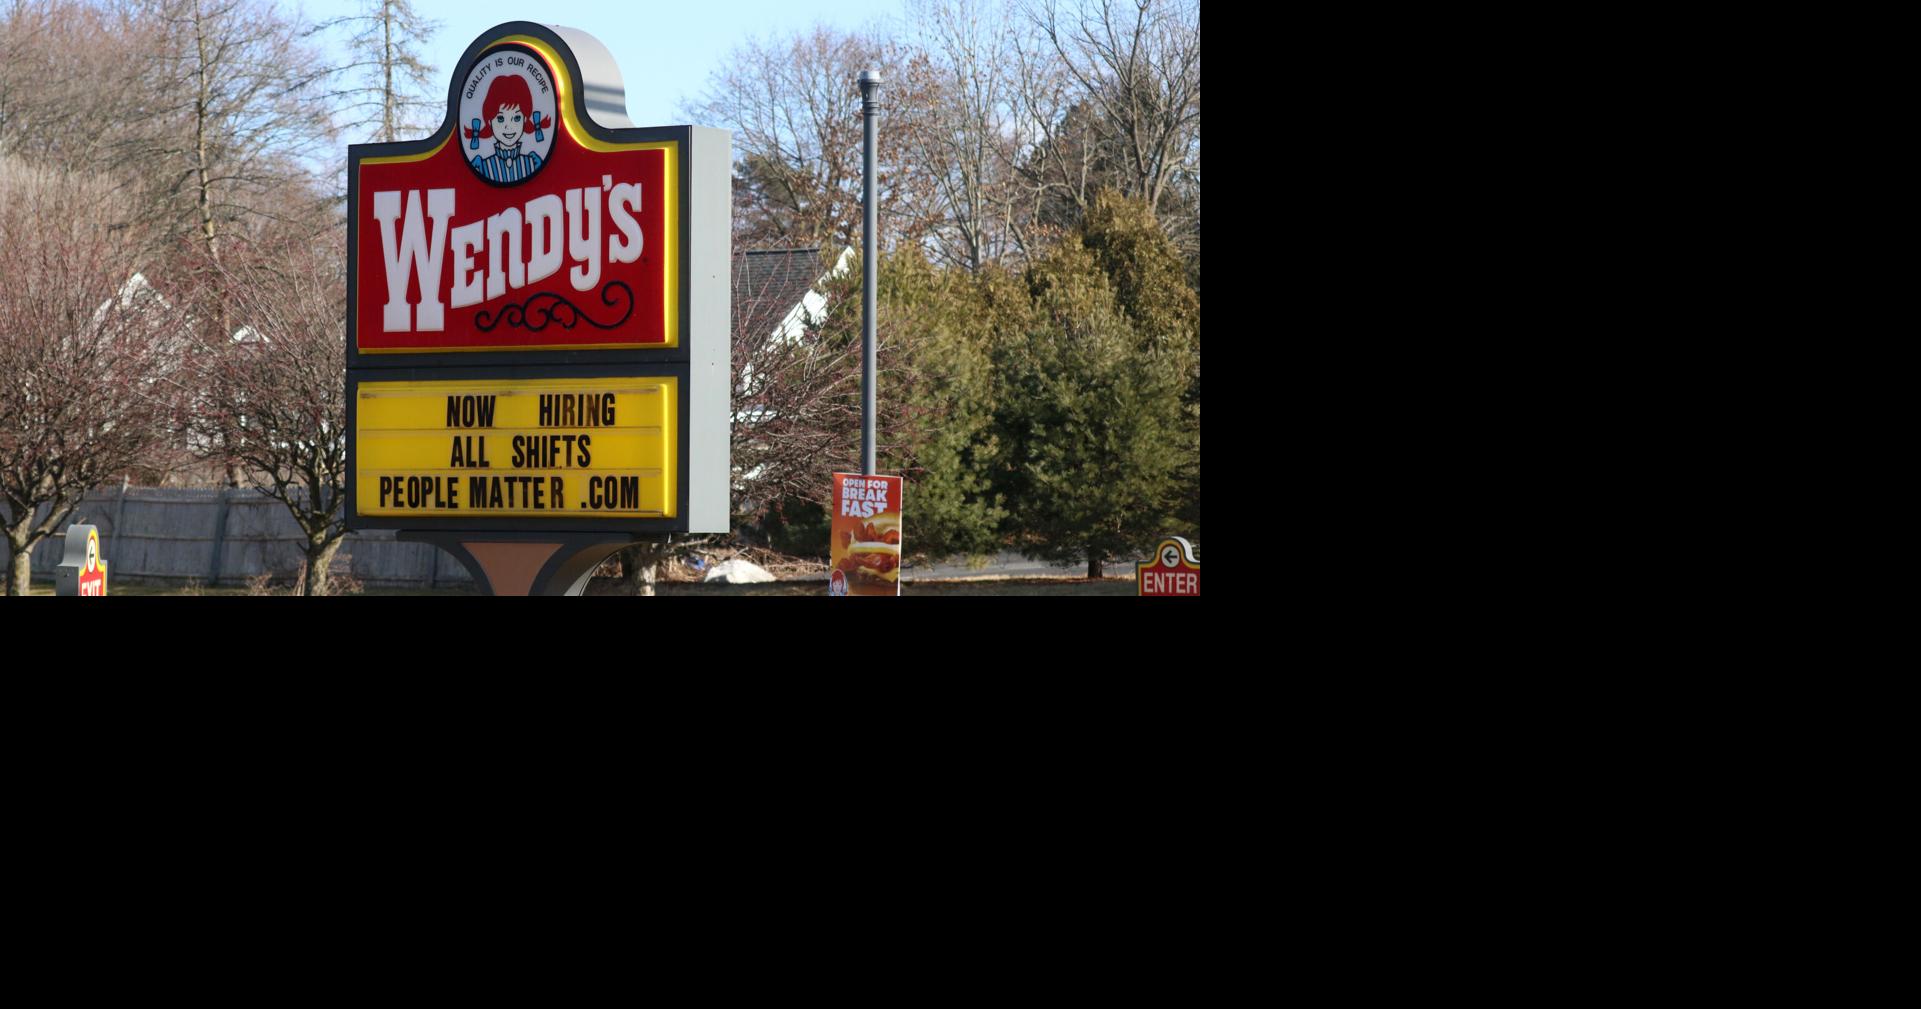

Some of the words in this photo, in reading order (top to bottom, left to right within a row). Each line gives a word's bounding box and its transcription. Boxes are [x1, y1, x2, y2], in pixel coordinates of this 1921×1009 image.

[465, 63, 492, 99] QUALITY
[494, 57, 503, 68] IS
[507, 56, 525, 68] OUR
[526, 63, 549, 94] RECIPE
[446, 395, 496, 428] NOW
[538, 392, 616, 427] HIRING
[450, 435, 490, 468] ALL
[511, 434, 592, 468] SHIFTS
[379, 476, 459, 509] PEOPLE
[580, 476, 640, 509] .COM
[841, 487, 888, 503] BREAK
[842, 478, 866, 488] OPEN
[867, 480, 888, 490] FOR
[841, 500, 888, 518] FAST
[81, 579, 101, 596] EXIT
[1143, 572, 1198, 594] ENTER
